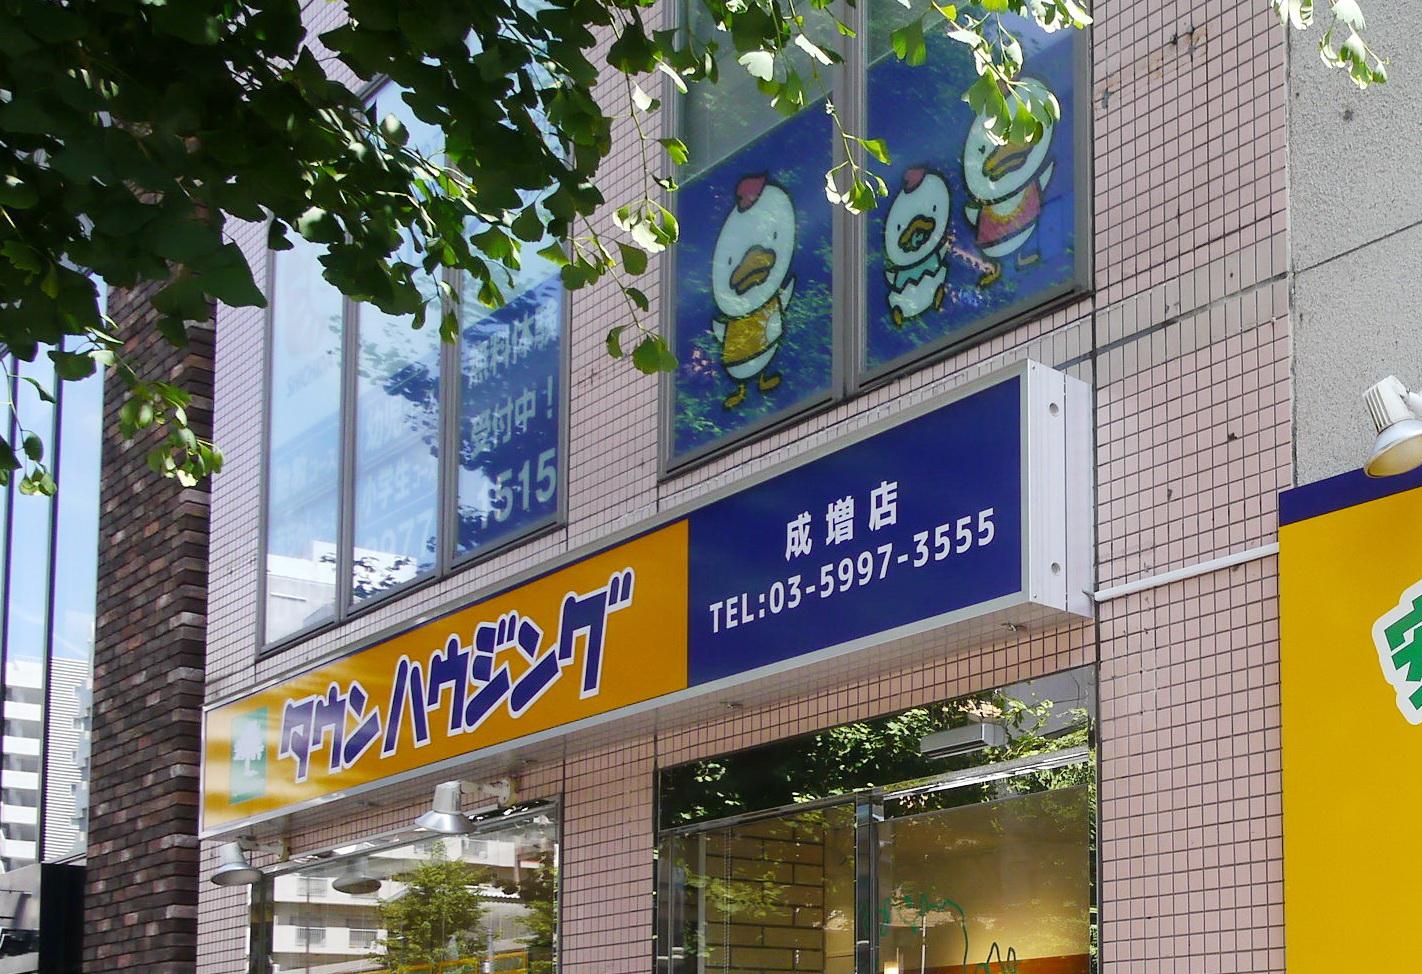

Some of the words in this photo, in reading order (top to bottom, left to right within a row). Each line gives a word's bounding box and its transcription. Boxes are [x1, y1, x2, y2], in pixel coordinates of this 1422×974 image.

[709, 507, 995, 634] TEL:03-5997-3555
[785, 480, 898, 562] 成増店
[279, 568, 634, 782] タウンハウジング
